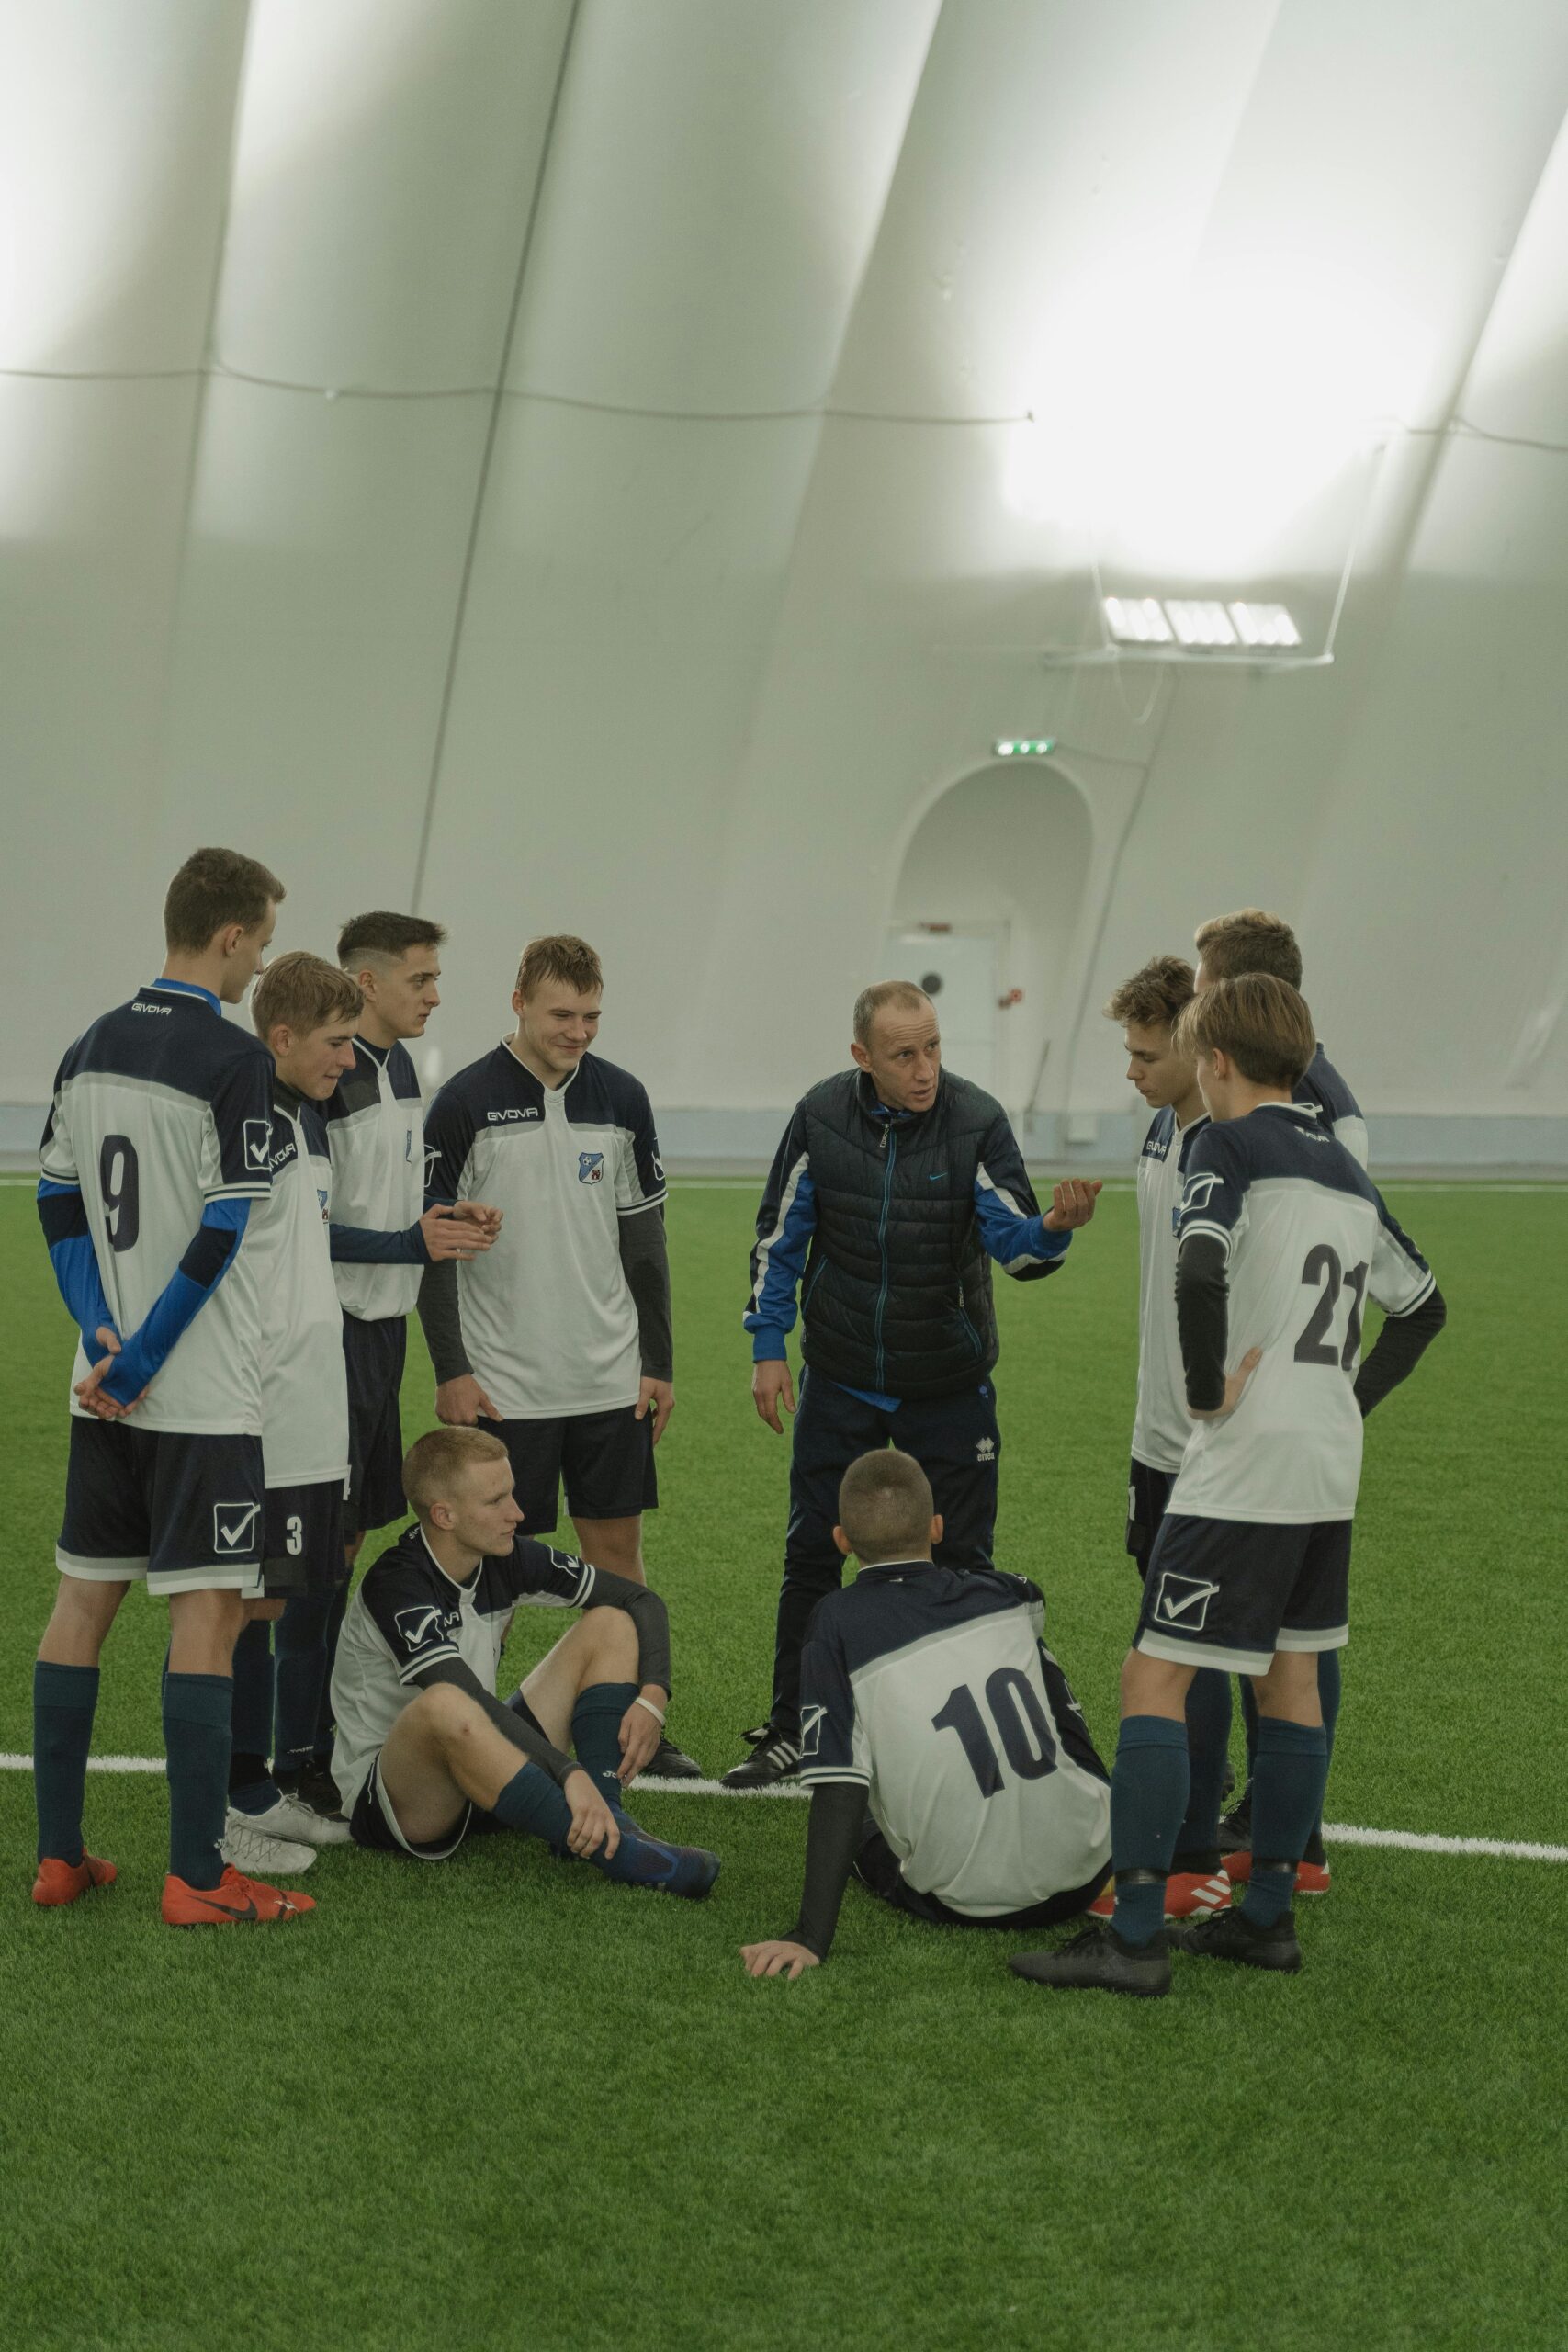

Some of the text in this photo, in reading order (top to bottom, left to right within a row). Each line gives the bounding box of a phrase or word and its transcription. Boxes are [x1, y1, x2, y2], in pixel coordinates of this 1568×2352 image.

[131, 1002, 172, 1015] GIVOVA
[487, 1107, 539, 1121] GVOVA
[268, 1143, 296, 1172] IVOVA
[100, 1134, 140, 1252] 9
[1293, 1243, 1369, 1372] 21
[286, 1516, 302, 1555] 3
[931, 1667, 1058, 1799] 10
